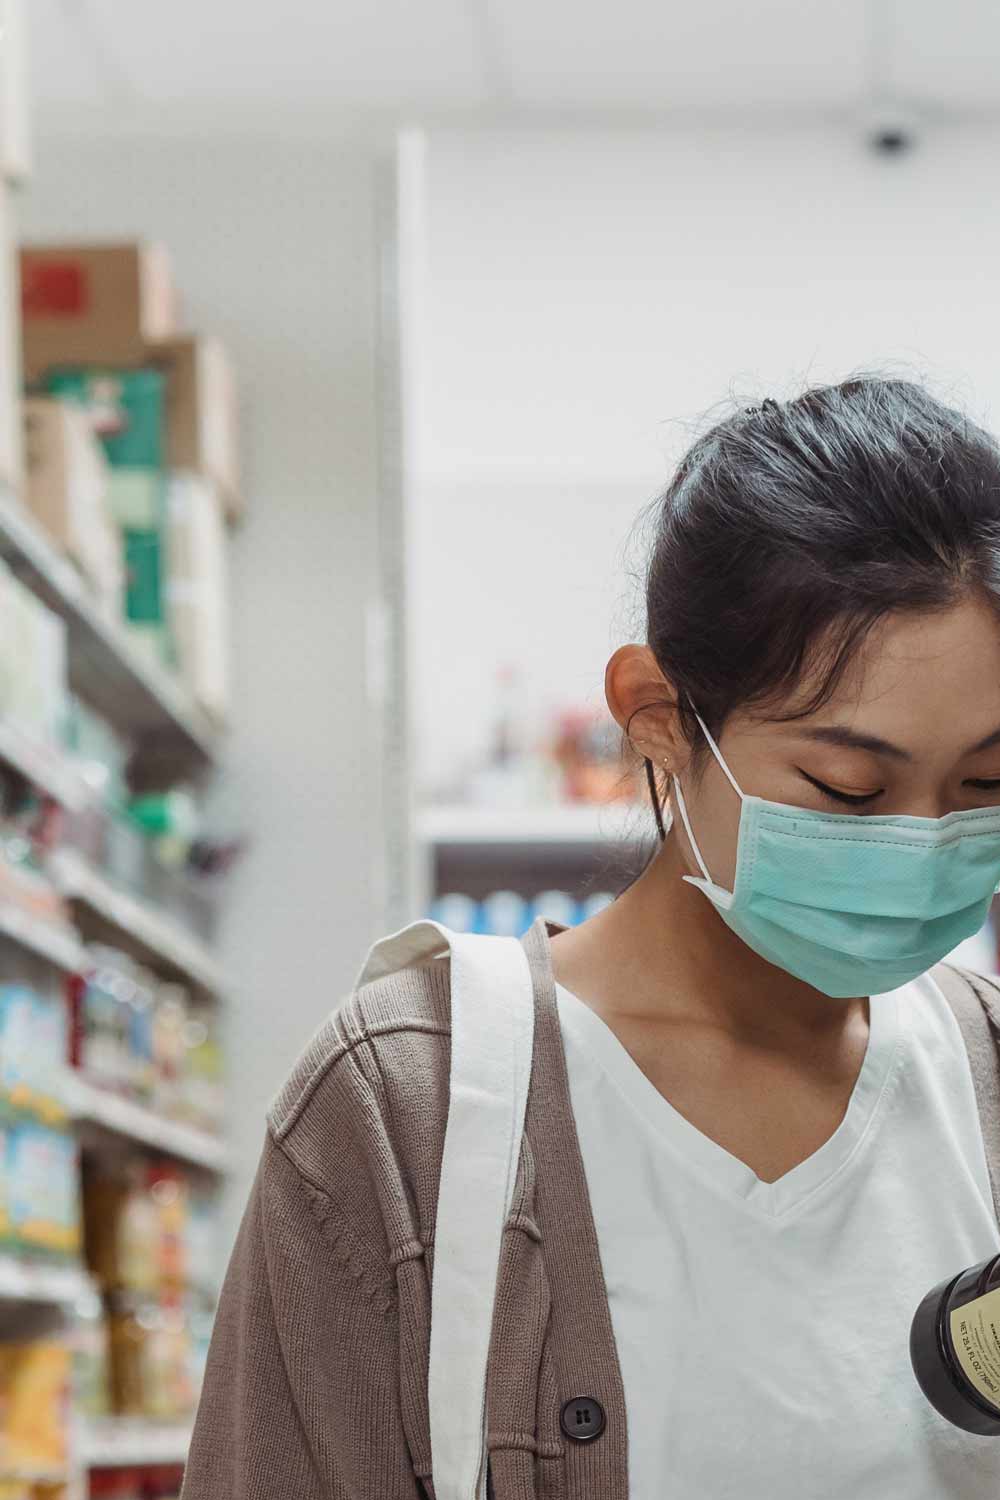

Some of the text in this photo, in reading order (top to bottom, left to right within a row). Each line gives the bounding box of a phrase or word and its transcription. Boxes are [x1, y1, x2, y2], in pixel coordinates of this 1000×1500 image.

[959, 1320, 968, 1336] NET
[962, 1337, 972, 1351] 25.4
[967, 1351, 976, 1362] FL
[972, 1361, 982, 1372] OZ
